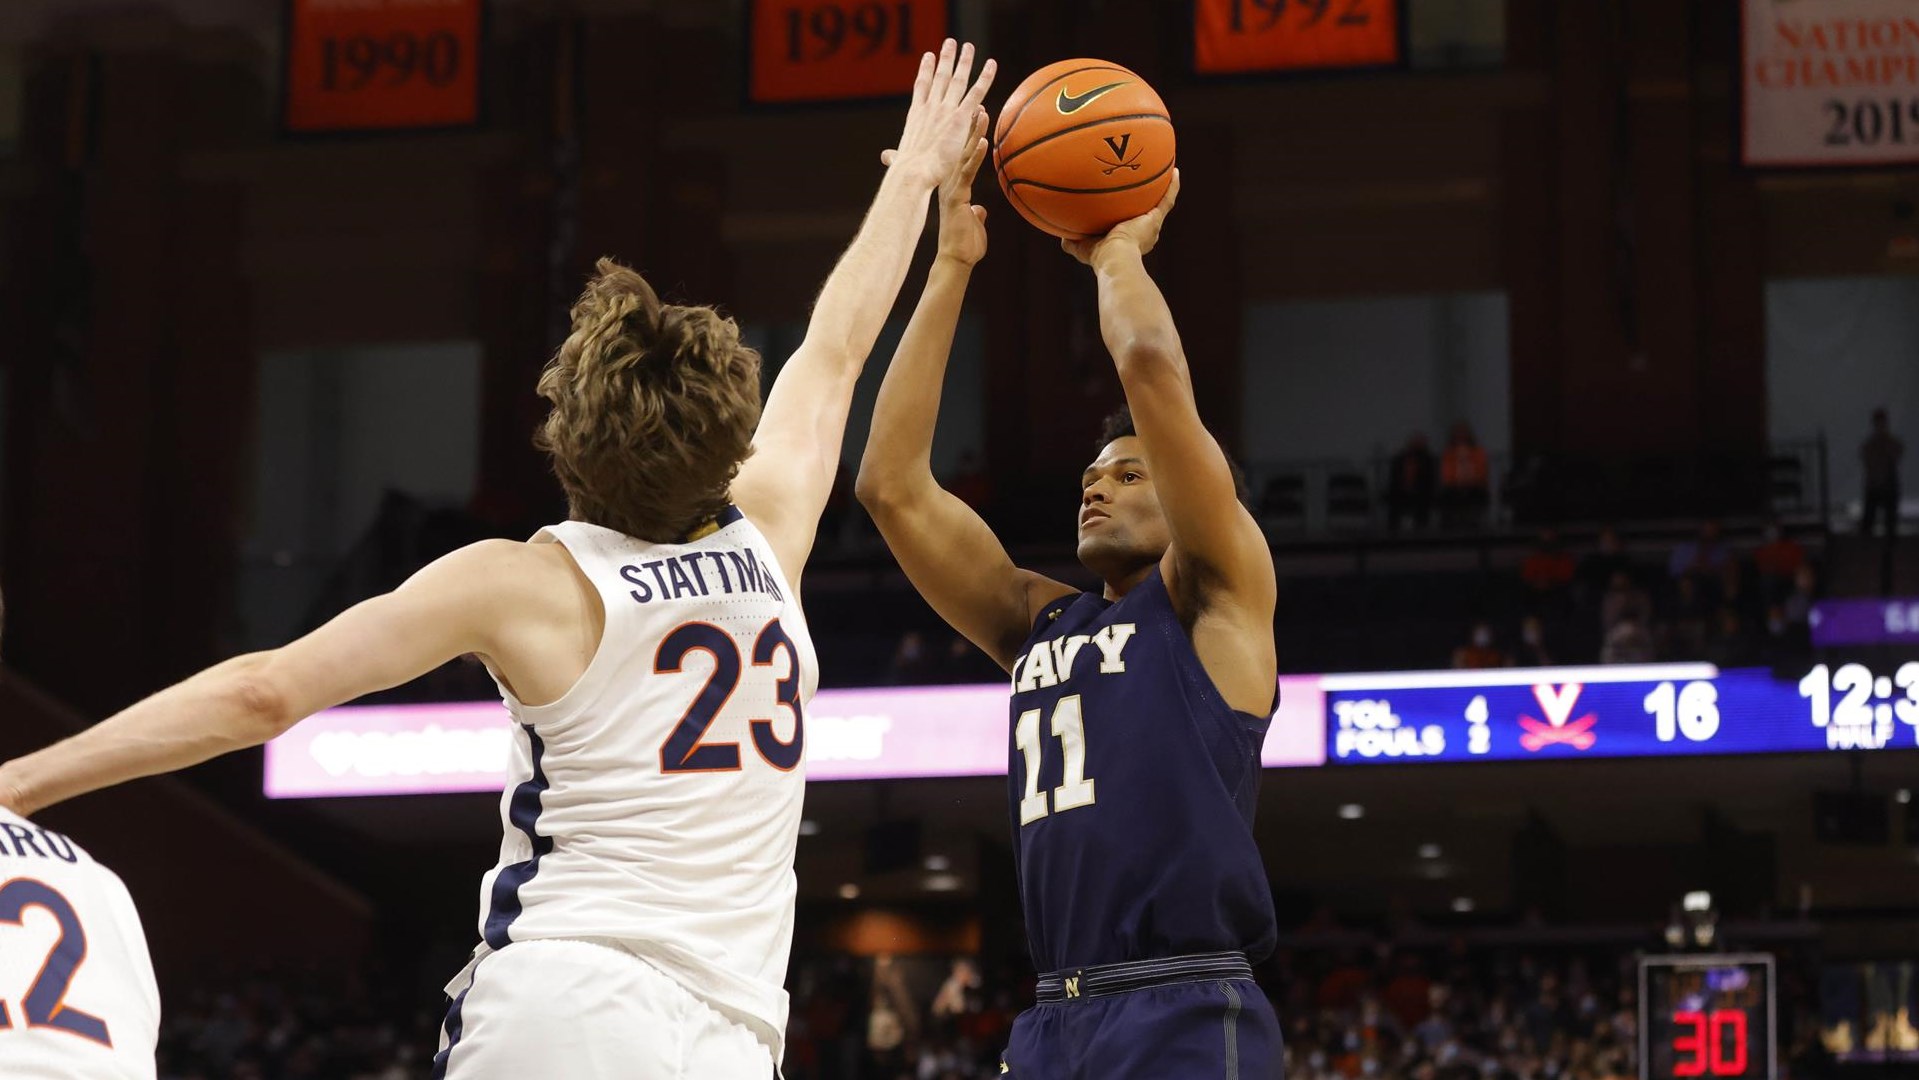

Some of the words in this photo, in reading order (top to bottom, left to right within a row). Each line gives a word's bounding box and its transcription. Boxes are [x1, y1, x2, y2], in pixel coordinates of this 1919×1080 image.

[320, 29, 460, 92] 1990
[785, 2, 915, 62] 1991
[653, 617, 804, 774] 23
[1643, 681, 1720, 742] 16
[1015, 694, 1096, 827] 11
[1336, 724, 1446, 758] FOULS
[0, 822, 78, 863] RU
[1672, 1009, 1748, 1077] 30
